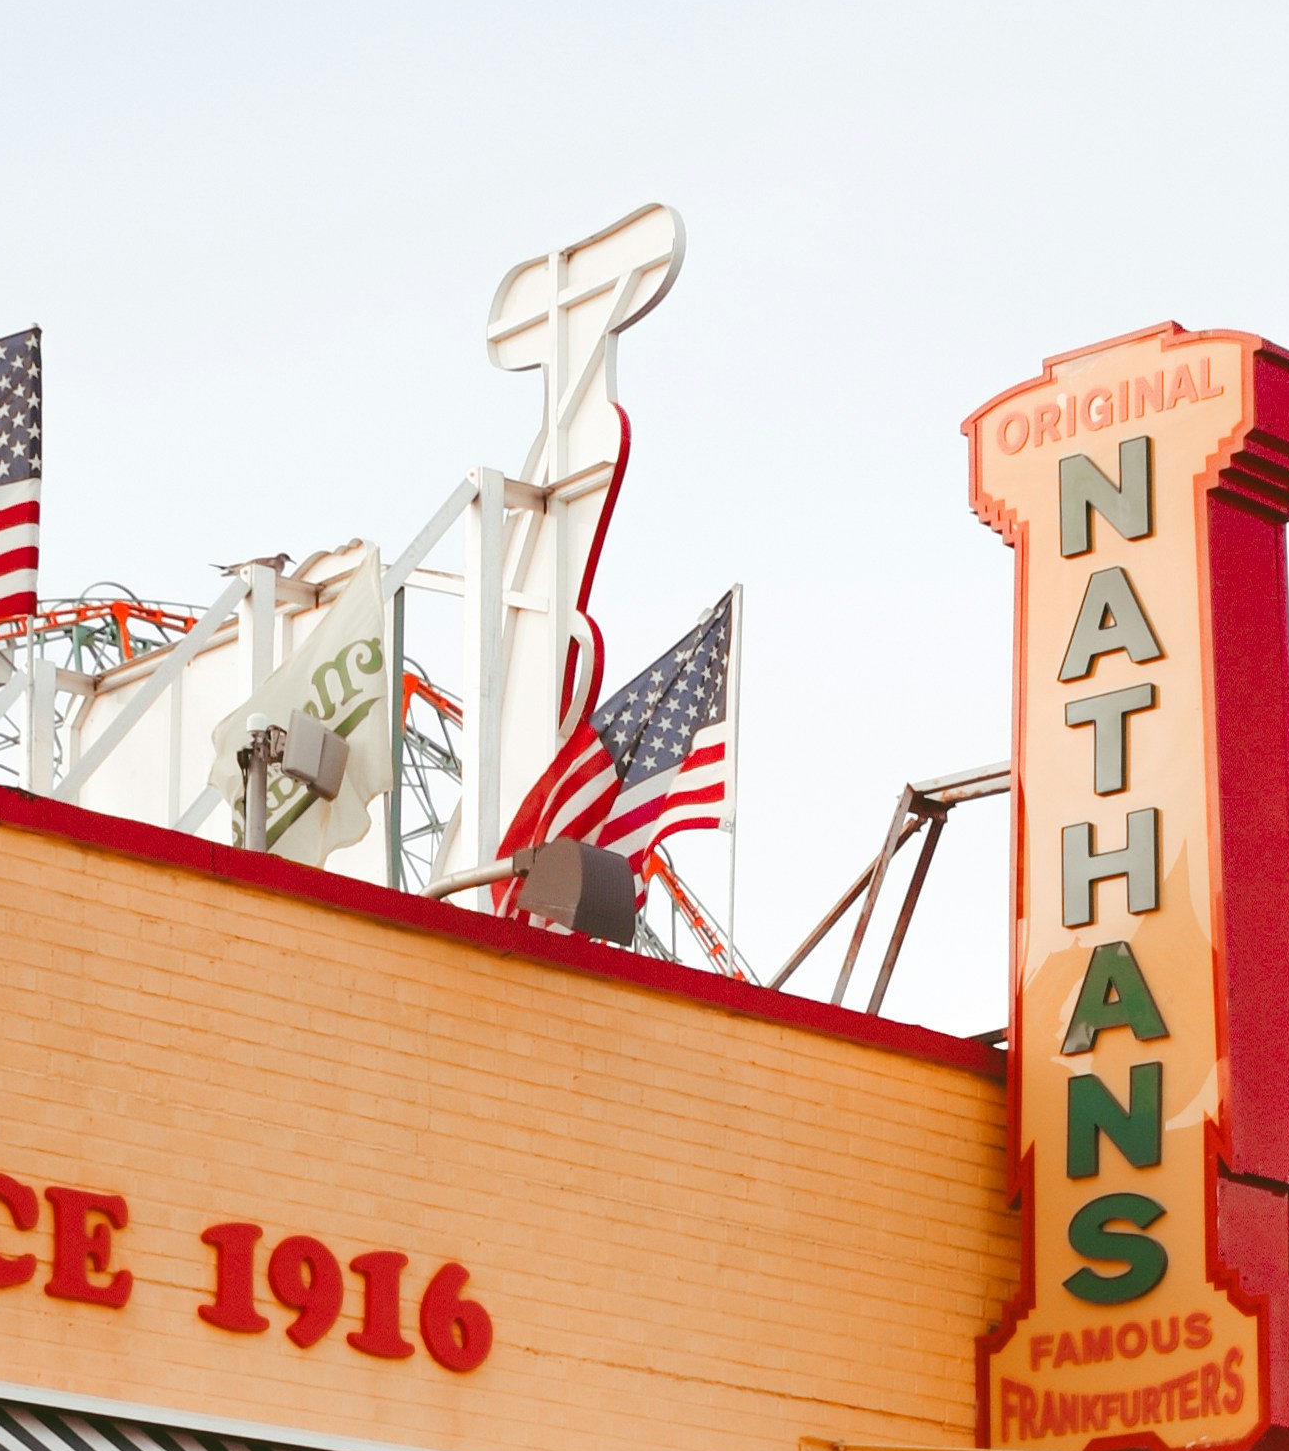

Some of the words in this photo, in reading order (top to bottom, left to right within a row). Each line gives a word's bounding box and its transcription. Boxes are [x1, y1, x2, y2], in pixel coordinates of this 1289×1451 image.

[996, 357, 1224, 456] ORIGINAL
[1057, 435, 1170, 1306] NATHANS
[197, 1221, 494, 1373] 1916
[1029, 1310, 1213, 1372] FAMOUS
[1000, 1347, 1245, 1443] FRANKFURTERS
